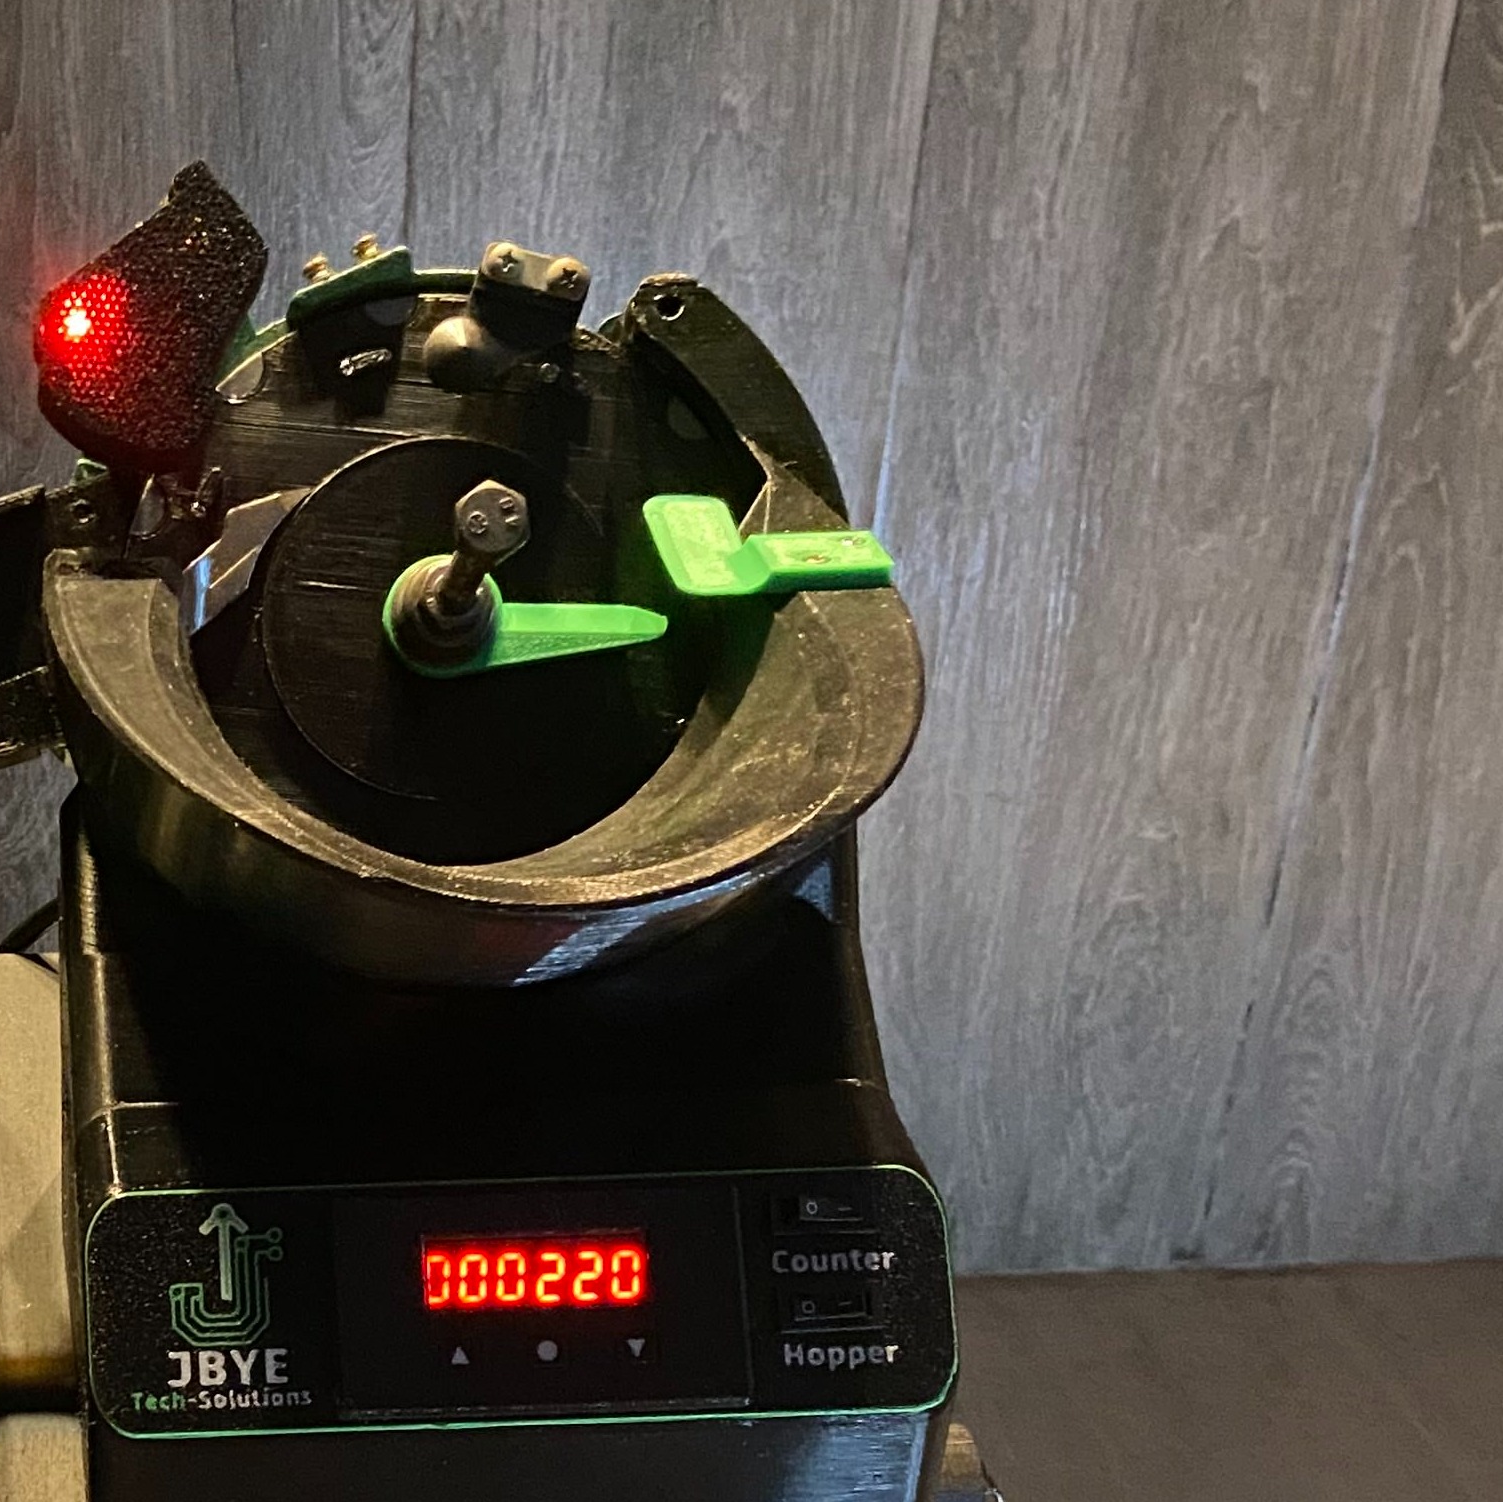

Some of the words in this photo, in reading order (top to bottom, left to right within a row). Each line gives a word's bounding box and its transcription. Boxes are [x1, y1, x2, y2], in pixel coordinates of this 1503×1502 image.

[772, 1250, 895, 1273] Counter
[427, 1250, 641, 1304] 000220
[167, 1348, 288, 1387] JBYE
[784, 1343, 899, 1371] Hopper
[131, 1388, 312, 1411] Tech-Solutions
